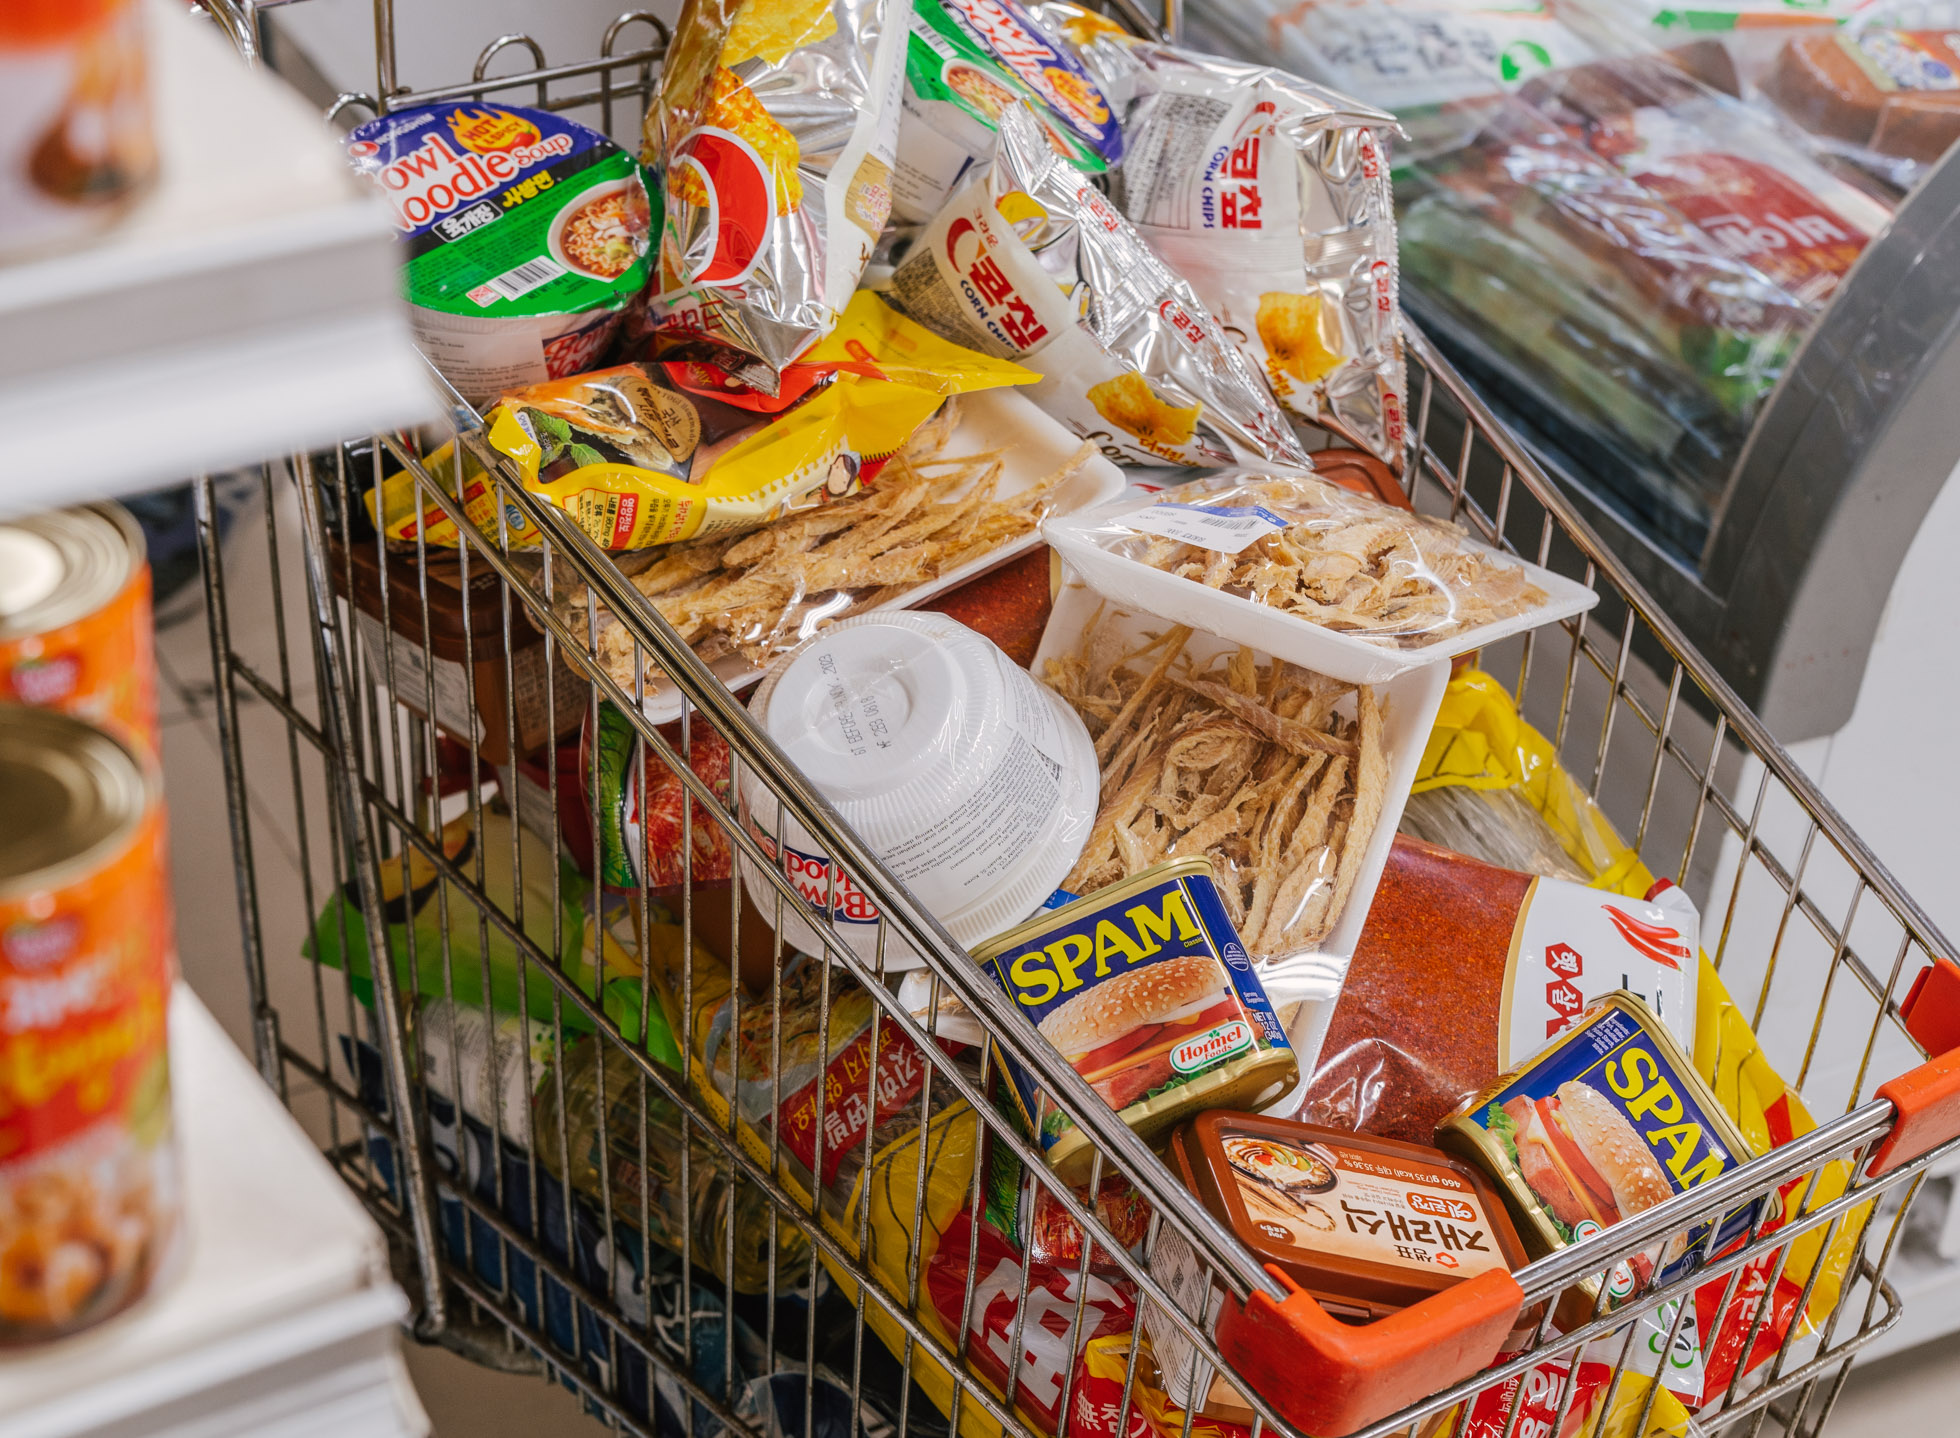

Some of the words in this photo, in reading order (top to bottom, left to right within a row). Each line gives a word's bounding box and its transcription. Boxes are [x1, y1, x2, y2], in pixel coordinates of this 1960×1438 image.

[462, 120, 498, 141] HOT
[381, 135, 457, 190] owl
[513, 135, 569, 166] Soup
[1203, 146, 1229, 182] CORN
[502, 169, 555, 207] 사발면
[1202, 187, 1215, 229] CHIPS
[960, 279, 988, 319] CORN
[987, 321, 1021, 353] CHIP
[969, 255, 1048, 350] 콘칩
[1172, 311, 1206, 344] 콘칩
[618, 497, 635, 533] 영양정보
[816, 652, 838, 677] 2023
[790, 878, 880, 919] Bow
[1010, 889, 1200, 1006] SPAM
[1184, 937, 1204, 948] Classic
[1551, 948, 1580, 1014] 햇살
[1253, 1012, 1265, 1022] NET
[1180, 1026, 1241, 1063] Hormel
[1205, 1045, 1232, 1060] Foods
[1442, 1178, 1461, 1188] 460
[1411, 1194, 1473, 1219] 옛된장
[1340, 1200, 1490, 1252] 재래식
[1394, 1244, 1432, 1263] 샘표
